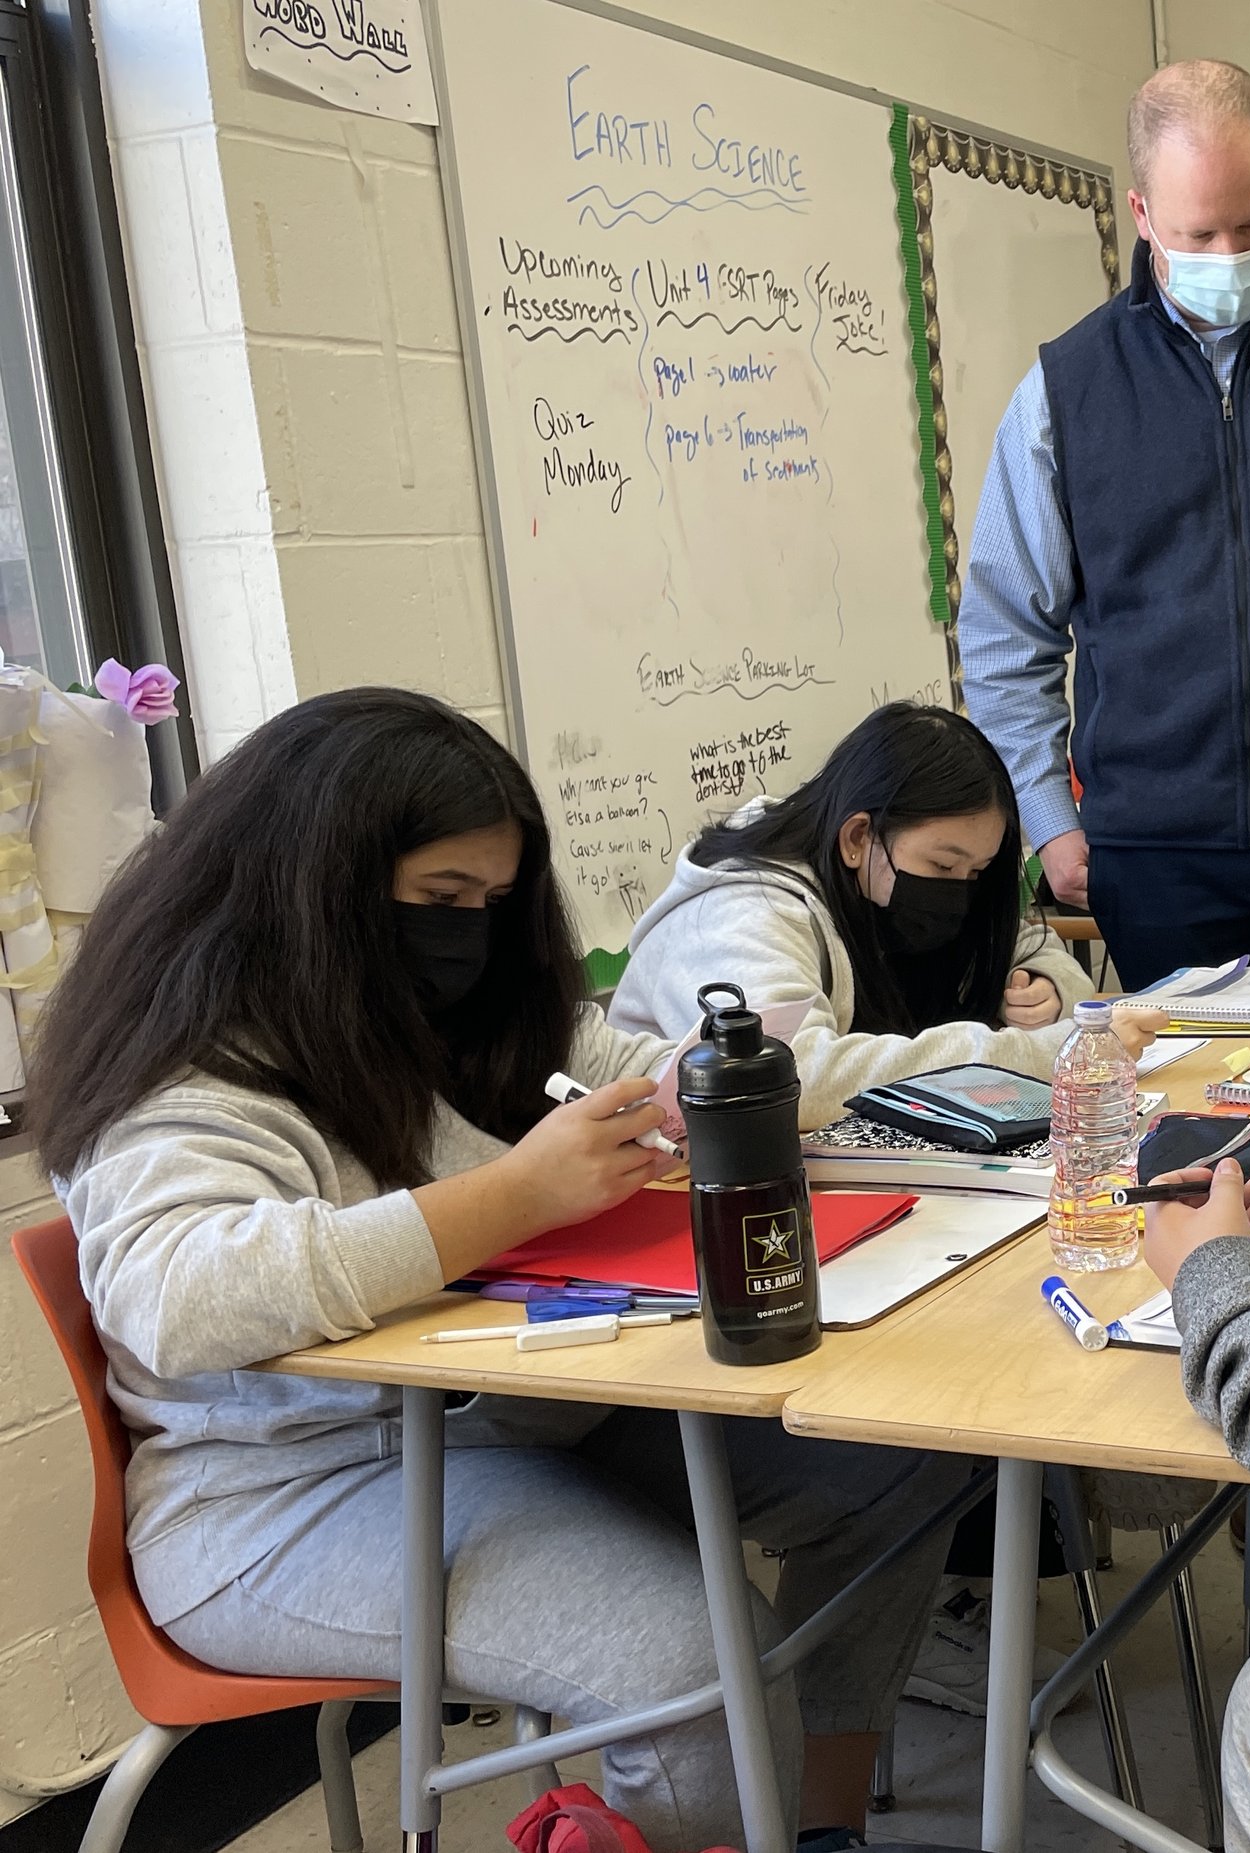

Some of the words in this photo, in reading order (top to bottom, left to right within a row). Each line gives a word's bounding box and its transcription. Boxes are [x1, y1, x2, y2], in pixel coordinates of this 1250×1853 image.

[691, 104, 807, 192] SCIENCE
[499, 236, 622, 293] Upcoming
[647, 259, 692, 308] Unit
[696, 262, 711, 300] 4
[503, 284, 638, 332] Assessments
[814, 261, 873, 317] Friday
[728, 353, 778, 384] water
[532, 396, 595, 442] Quiz
[542, 446, 632, 515] Monday
[743, 456, 759, 483] of
[725, 740, 738, 754] is
[755, 719, 792, 745] best
[594, 810, 605, 824] a
[756, 1301, 804, 1320] goarmy.com
